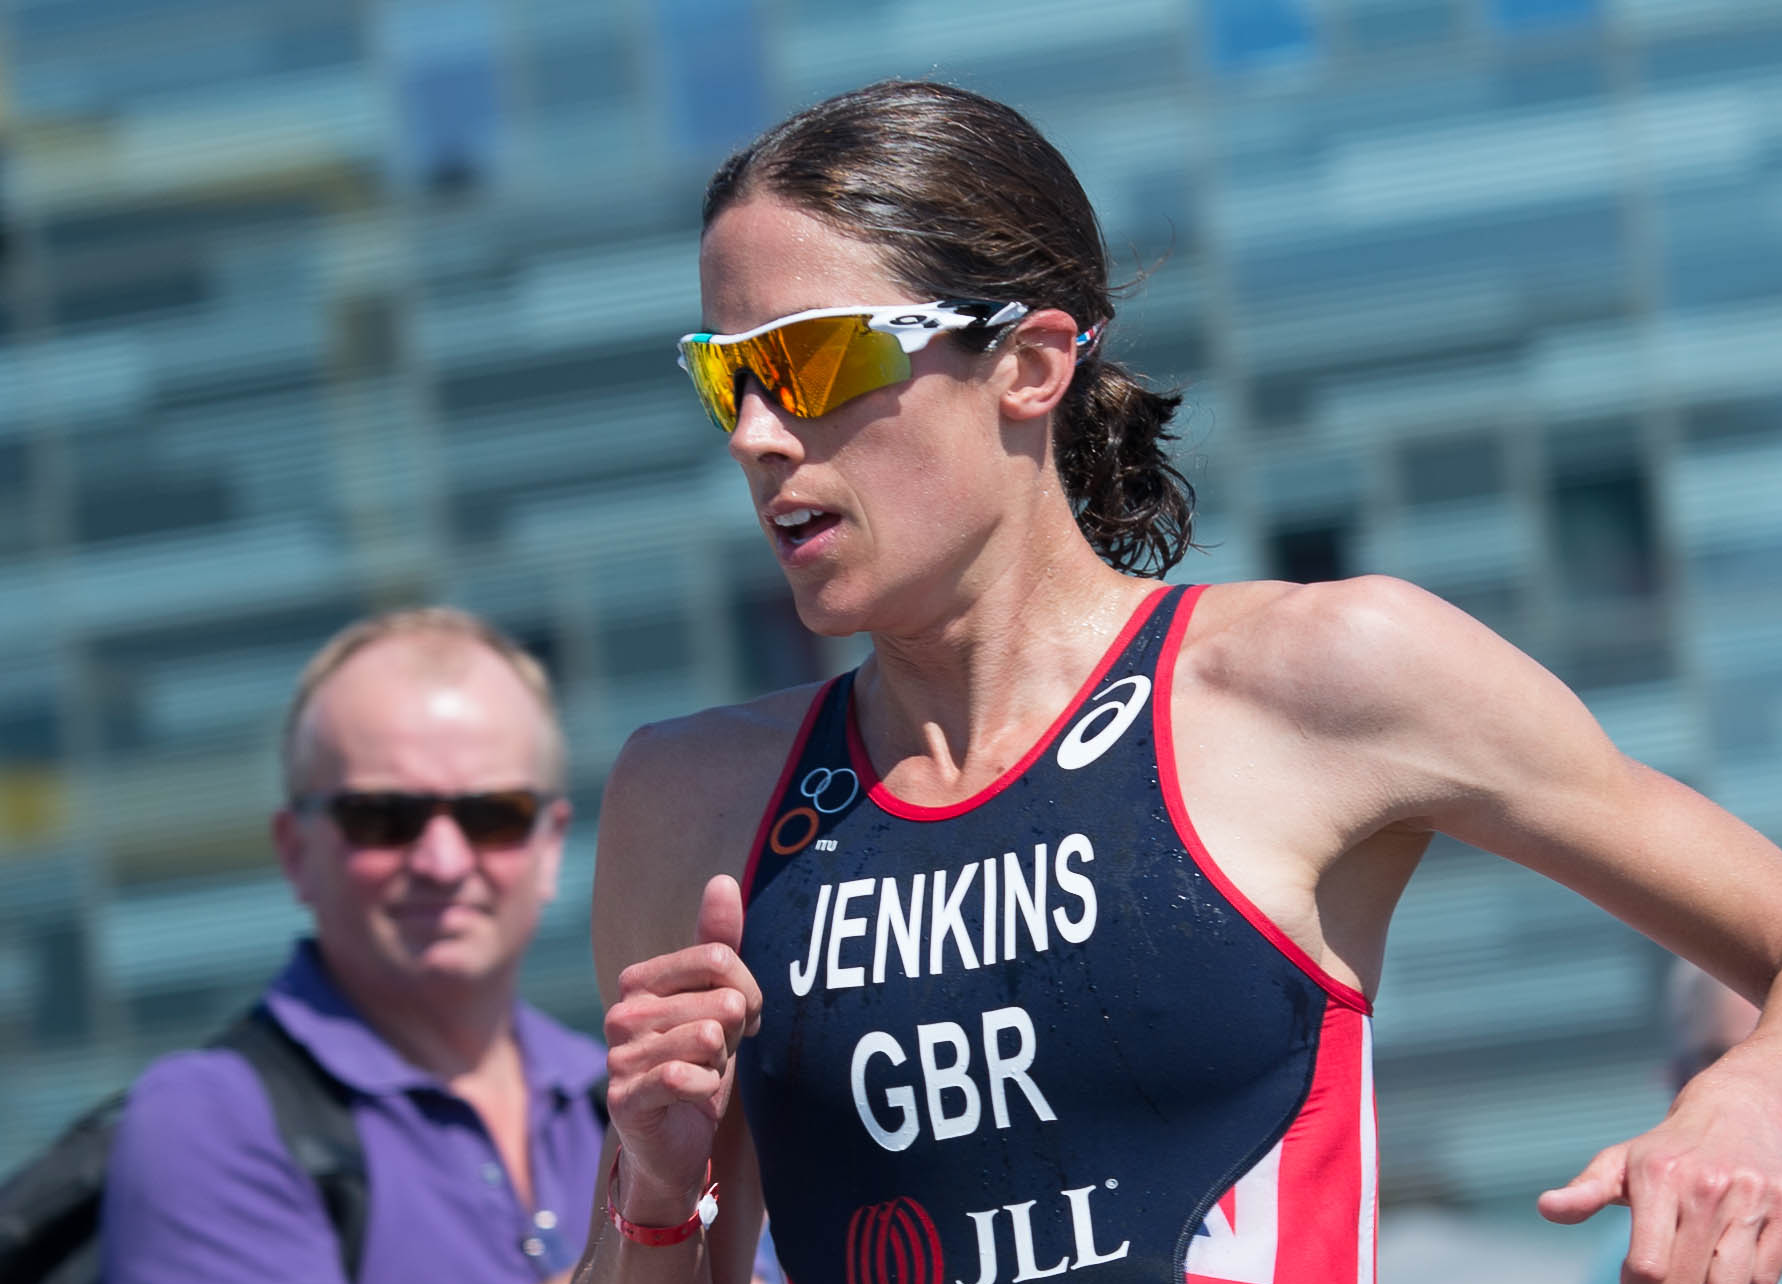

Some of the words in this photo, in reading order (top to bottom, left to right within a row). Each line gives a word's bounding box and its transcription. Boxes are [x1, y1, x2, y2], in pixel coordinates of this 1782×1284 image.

[789, 833, 1098, 997] JENKINS
[814, 839, 838, 852] ITU
[850, 1006, 1058, 1152] GBR
